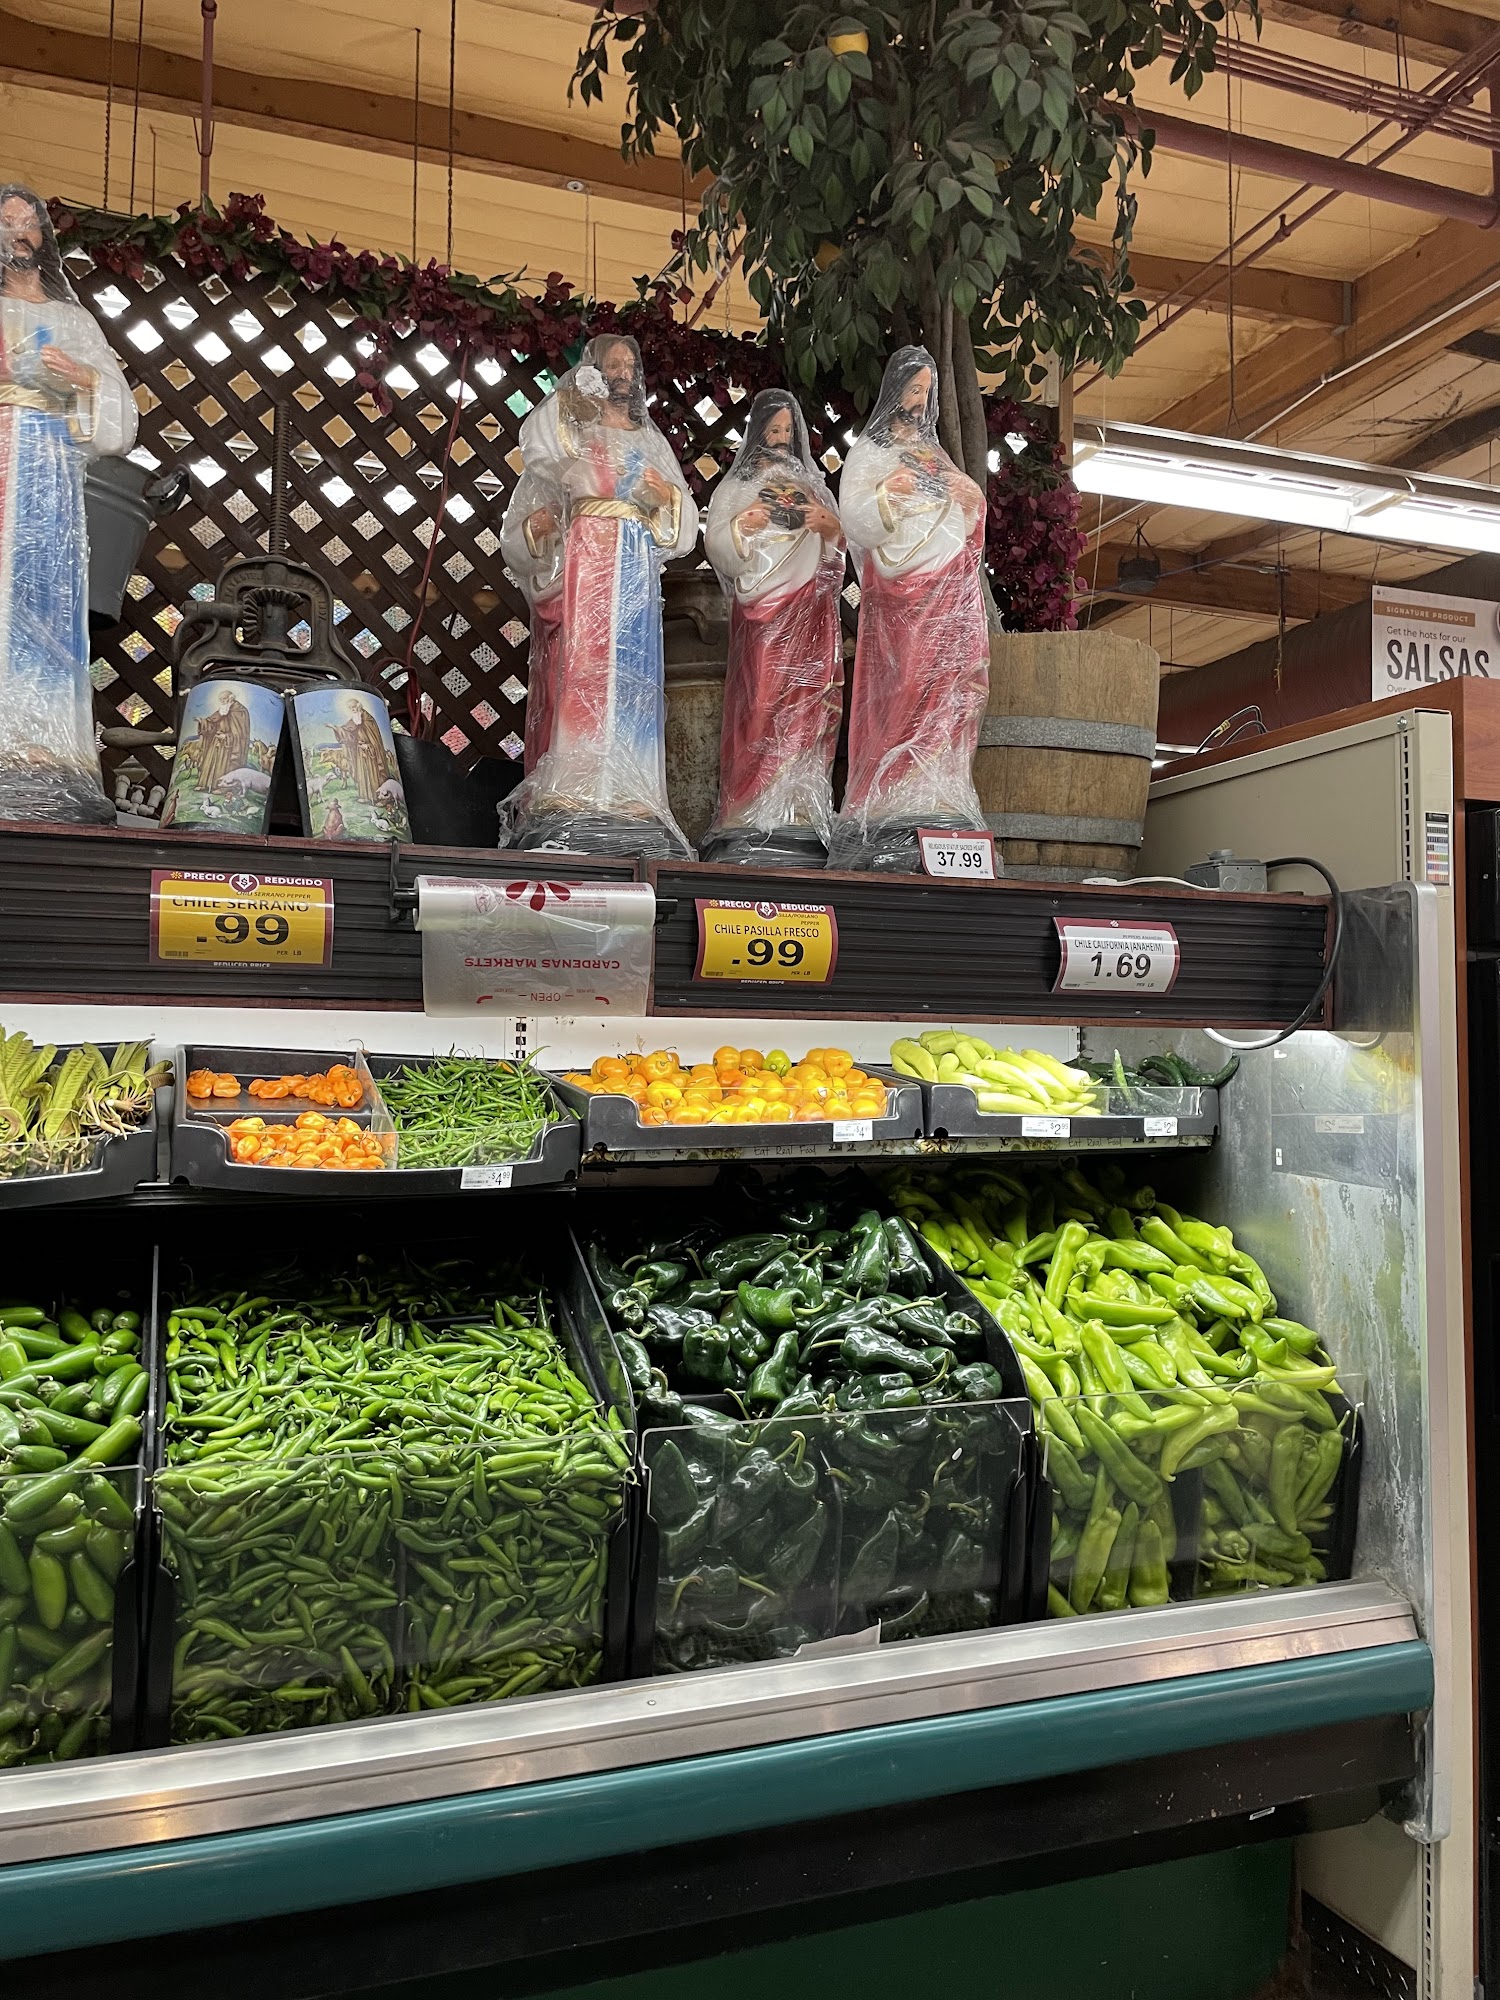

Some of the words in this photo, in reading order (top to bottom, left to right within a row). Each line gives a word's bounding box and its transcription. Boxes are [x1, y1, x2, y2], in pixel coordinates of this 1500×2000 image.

[1386, 606, 1429, 618] SIGNATURE
[1432, 612, 1468, 622] PRODUCT
[1386, 626, 1402, 636] Get
[1404, 628, 1417, 638] the
[1420, 630, 1437, 640] hots
[1439, 632, 1450, 641] for
[1452, 636, 1466, 644] our
[1386, 639, 1490, 682] SALSAS
[937, 851, 982, 868] 37.99
[184, 872, 226, 881] PRECIO
[264, 877, 323, 887] REDUCIDO
[172, 896, 222, 908] CHILE
[226, 898, 310, 912] SERRANO
[719, 900, 751, 909] PRECIO
[781, 903, 826, 912] REDUCIDO
[196, 912, 290, 946] .99
[714, 924, 742, 935] CHILE
[744, 925, 782, 936] PASILLA
[784, 927, 819, 938] FRESCO
[731, 938, 804, 967] .99
[1075, 940, 1092, 949] CHILE
[1093, 940, 1130, 950] CALIFORNIA
[1131, 942, 1164, 954] (ANAHEIM)
[464, 957, 537, 968] MARKETS
[542, 958, 620, 969] CARDENAS
[1090, 952, 1151, 978] 1.69
[530, 993, 560, 1001] OPEN
